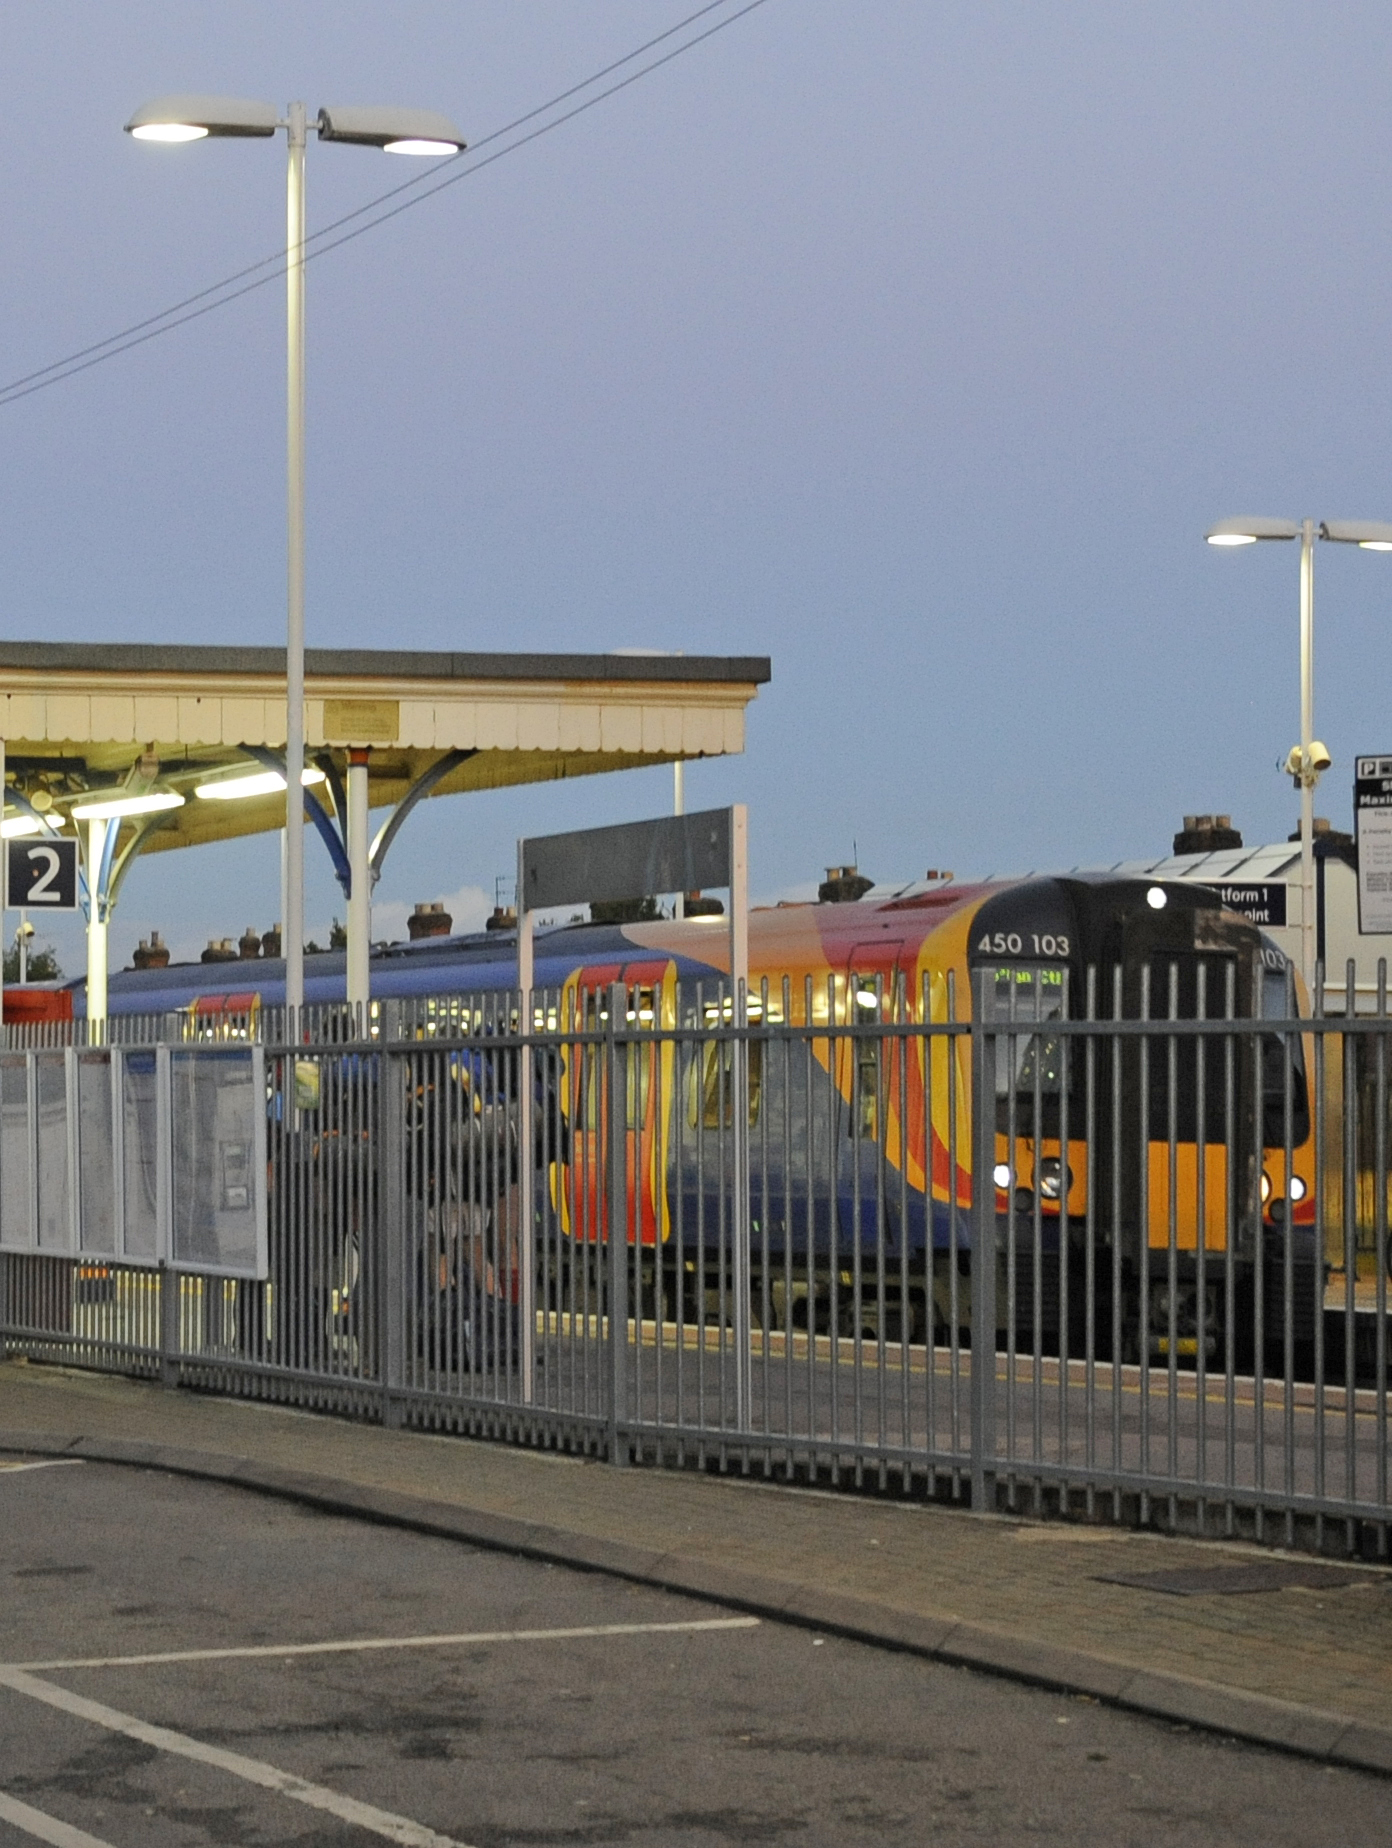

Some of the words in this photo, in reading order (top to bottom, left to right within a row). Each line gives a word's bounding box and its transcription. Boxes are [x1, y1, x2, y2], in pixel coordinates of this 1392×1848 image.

[27, 846, 60, 901] 2
[1221, 886, 1259, 902] tform
[1262, 886, 1269, 902] 1
[1244, 908, 1270, 922] oint
[978, 932, 1022, 953] 450
[1031, 934, 1069, 956] 103
